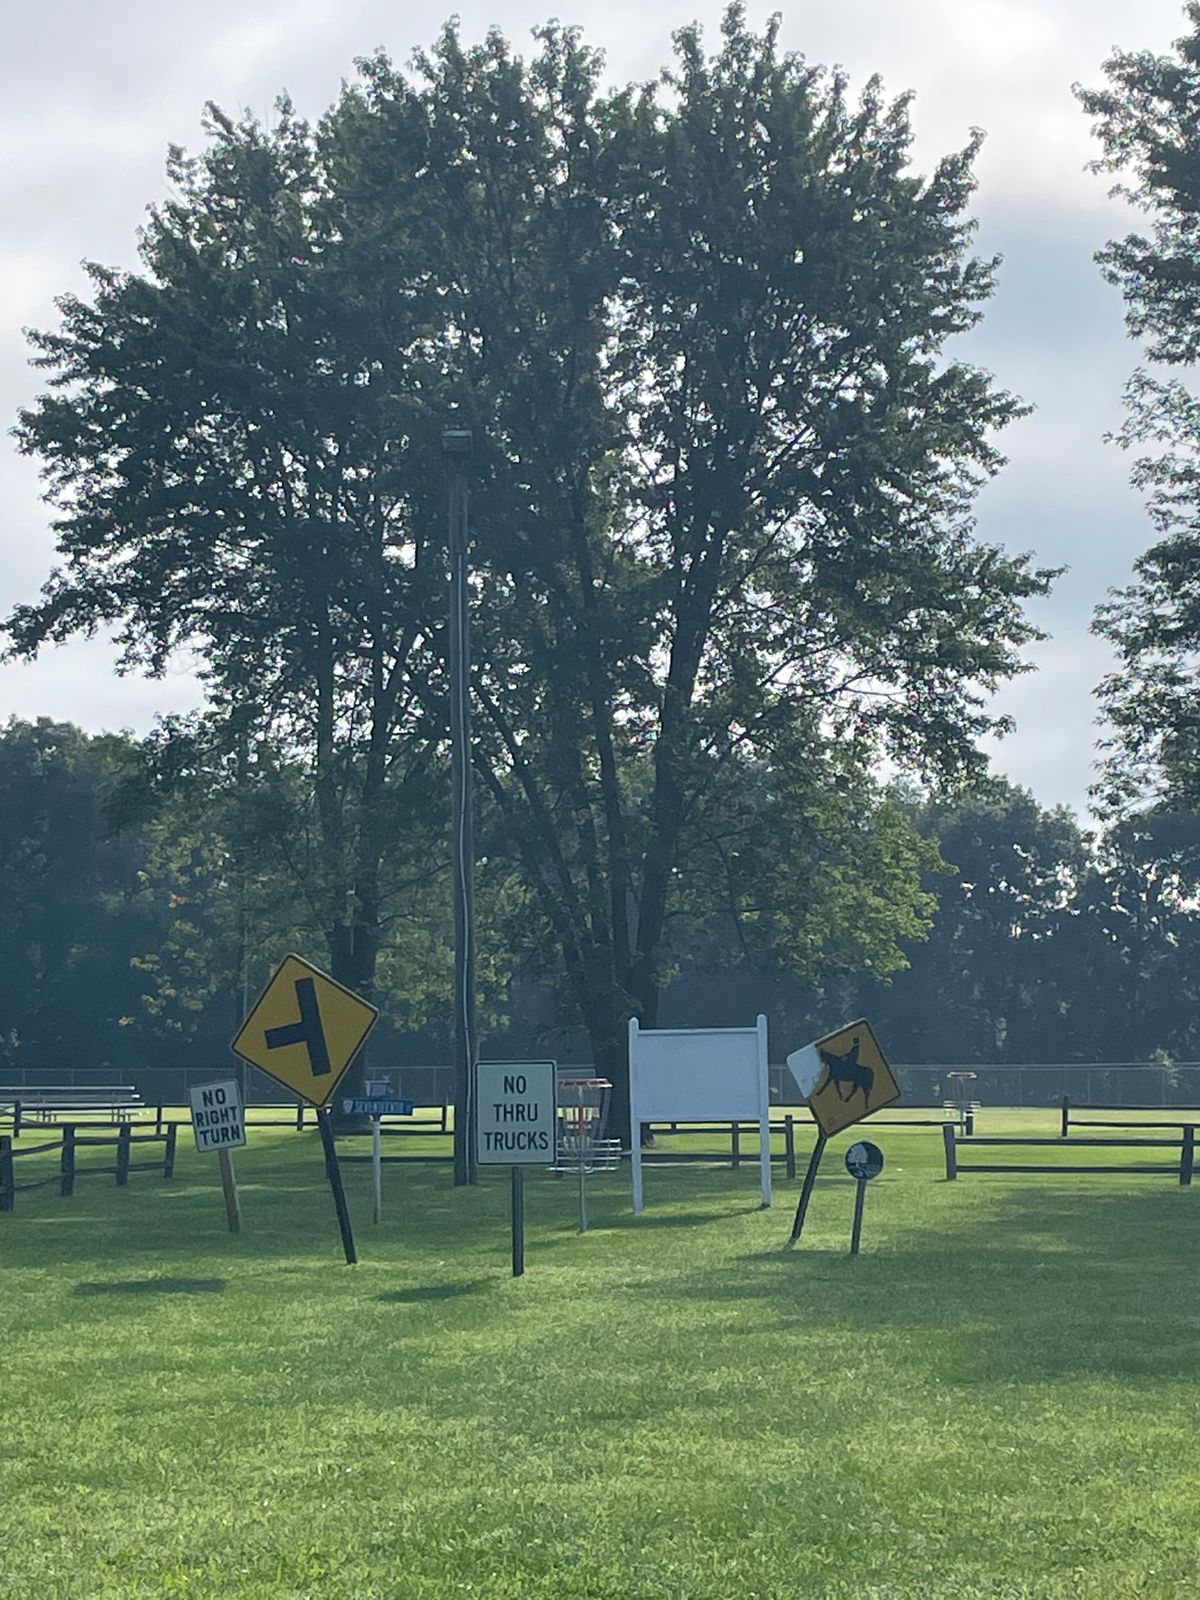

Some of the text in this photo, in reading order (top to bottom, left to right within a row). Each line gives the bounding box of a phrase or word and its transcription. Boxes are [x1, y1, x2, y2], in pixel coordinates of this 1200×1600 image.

[504, 1075, 527, 1094] NO
[202, 1088, 226, 1107] NO
[196, 1106, 238, 1128] RIGHT
[493, 1103, 538, 1122] THRU
[199, 1124, 241, 1146] TURN
[483, 1131, 549, 1150] TRUCKS
